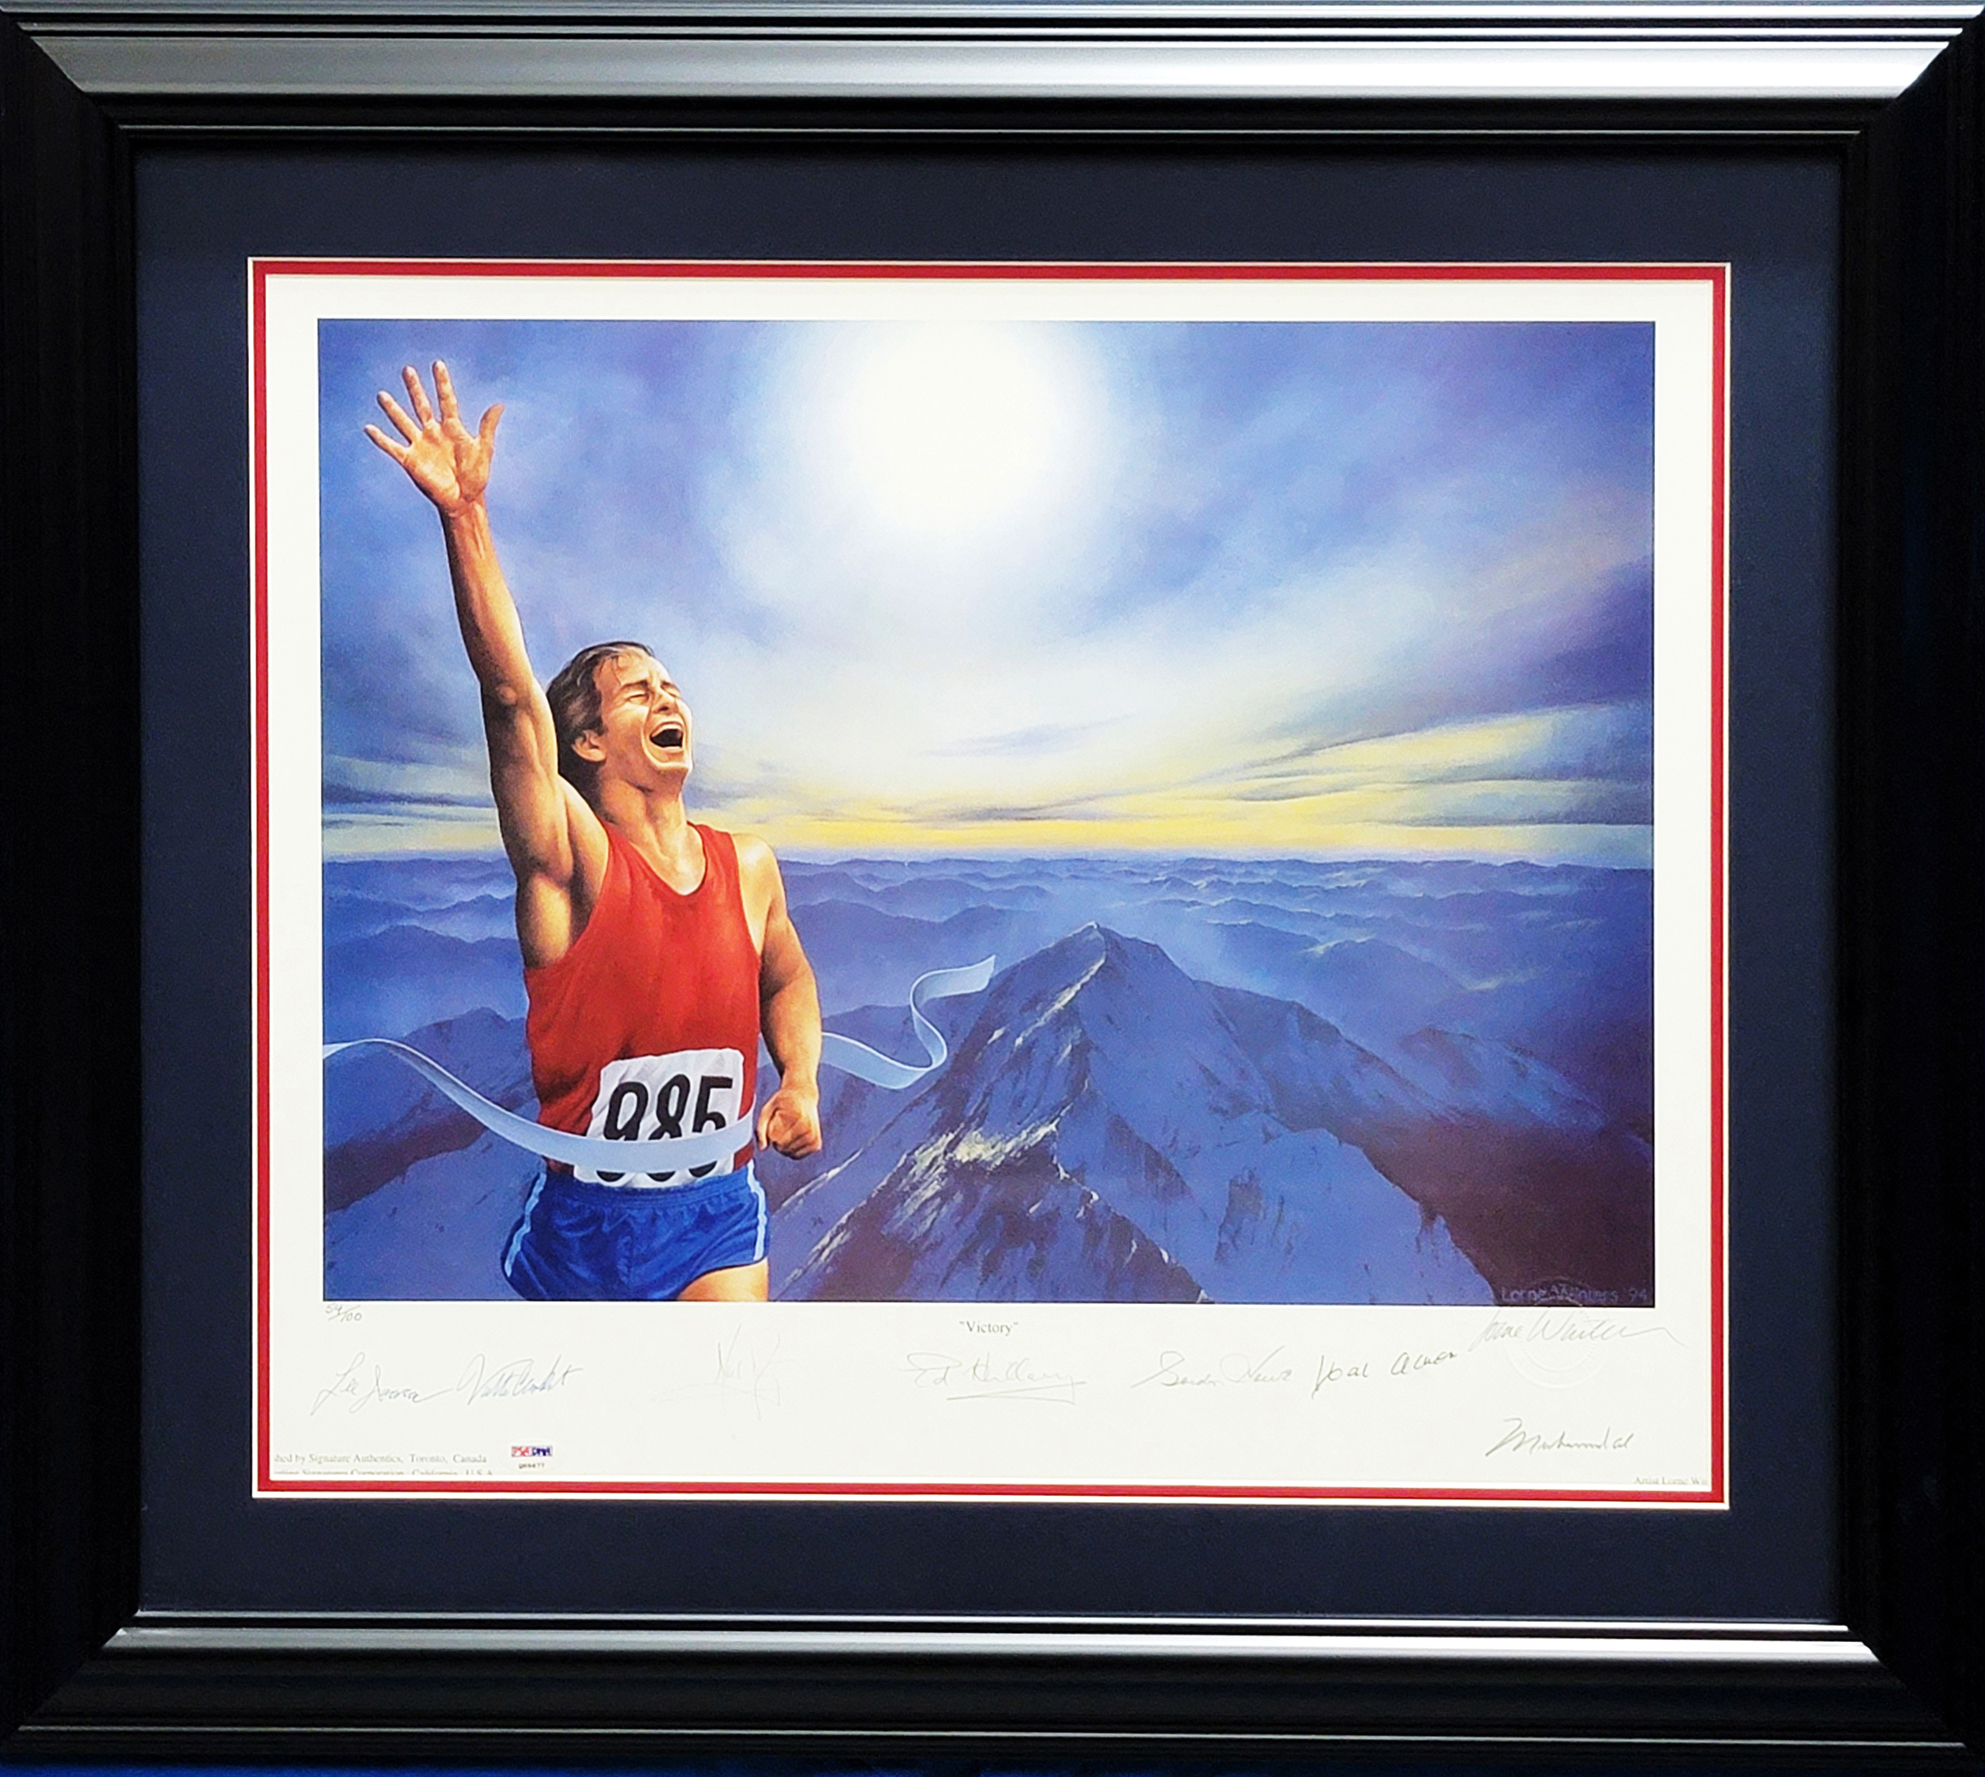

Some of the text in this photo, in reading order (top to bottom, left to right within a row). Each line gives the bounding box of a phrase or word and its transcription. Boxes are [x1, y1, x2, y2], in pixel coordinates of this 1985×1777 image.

[597, 1074, 733, 1182] 985
[959, 1320, 1019, 1336] "Victory"
[295, 1454, 304, 1465] by
[308, 1454, 350, 1464] Signature
[452, 1454, 487, 1464] Canada
